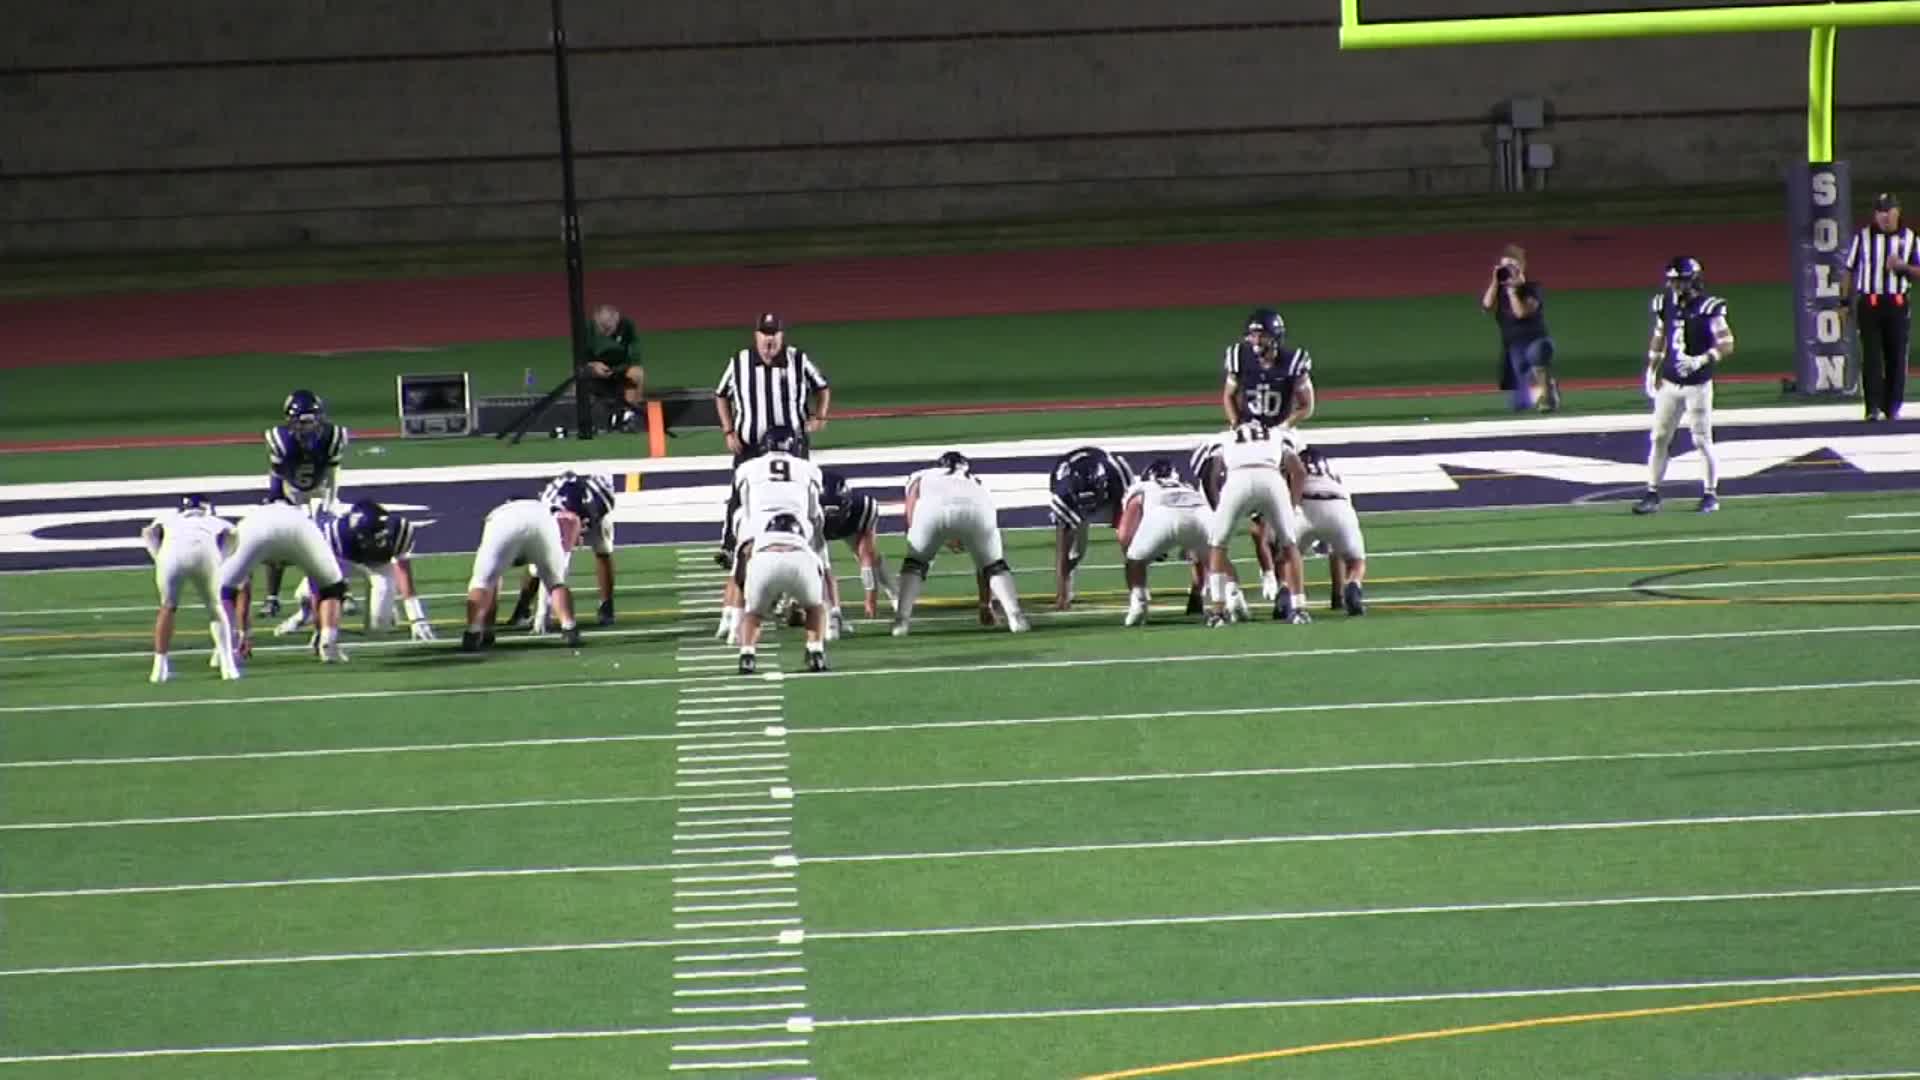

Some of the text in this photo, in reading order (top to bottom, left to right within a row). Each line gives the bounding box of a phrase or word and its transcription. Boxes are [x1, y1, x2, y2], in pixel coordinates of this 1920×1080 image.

[1812, 171, 1846, 392] SOLON
[1246, 389, 1283, 417] 30
[768, 459, 792, 482] 9
